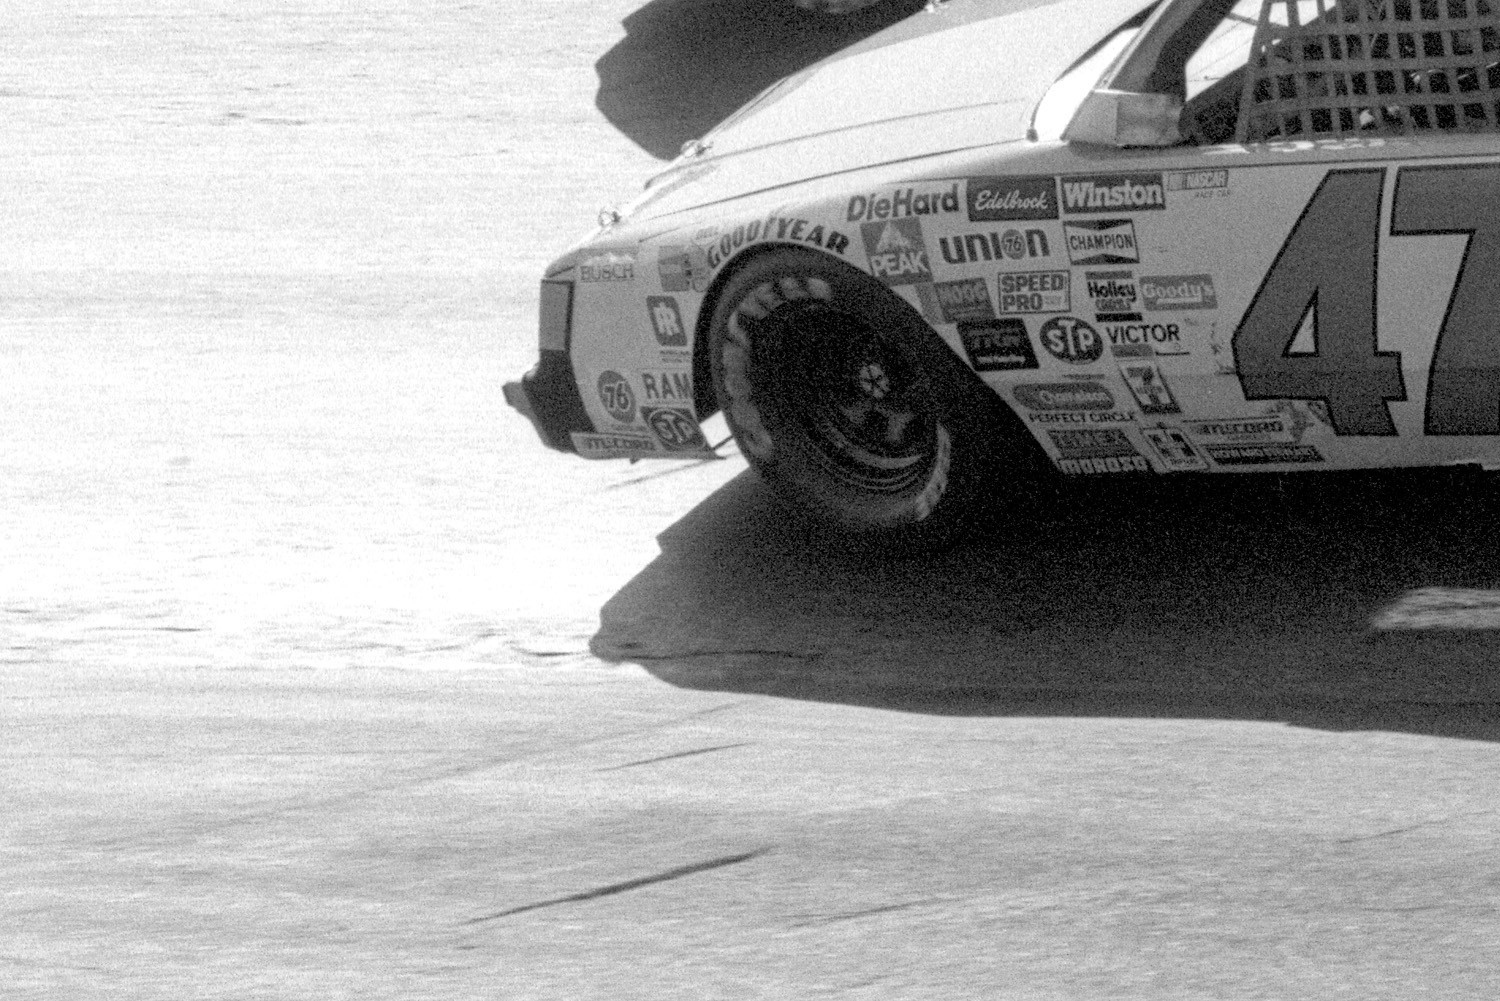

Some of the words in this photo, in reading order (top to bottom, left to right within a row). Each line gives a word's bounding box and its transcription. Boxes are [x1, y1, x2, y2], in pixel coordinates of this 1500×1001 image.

[847, 184, 960, 222] DieHard
[973, 189, 1050, 212] Edelbrock
[1063, 180, 1163, 209] Winston
[706, 217, 850, 270] GOODYEAR
[1069, 234, 1134, 252] CHAMPION
[580, 264, 635, 283] BUSCH
[870, 251, 931, 278] PEAK
[1001, 274, 1064, 295] SPEED
[1088, 281, 1136, 303] Holley
[1003, 294, 1043, 312] PRO
[1047, 319, 1094, 357] STP
[1106, 324, 1180, 344] VICTOR
[603, 382, 630, 412] 76
[641, 371, 693, 401] RAM
[656, 413, 697, 445] STP
[1028, 412, 1086, 424] PERFECT
[1089, 411, 1138, 423] CIRCLE
[1060, 454, 1147, 474] MOROSO
